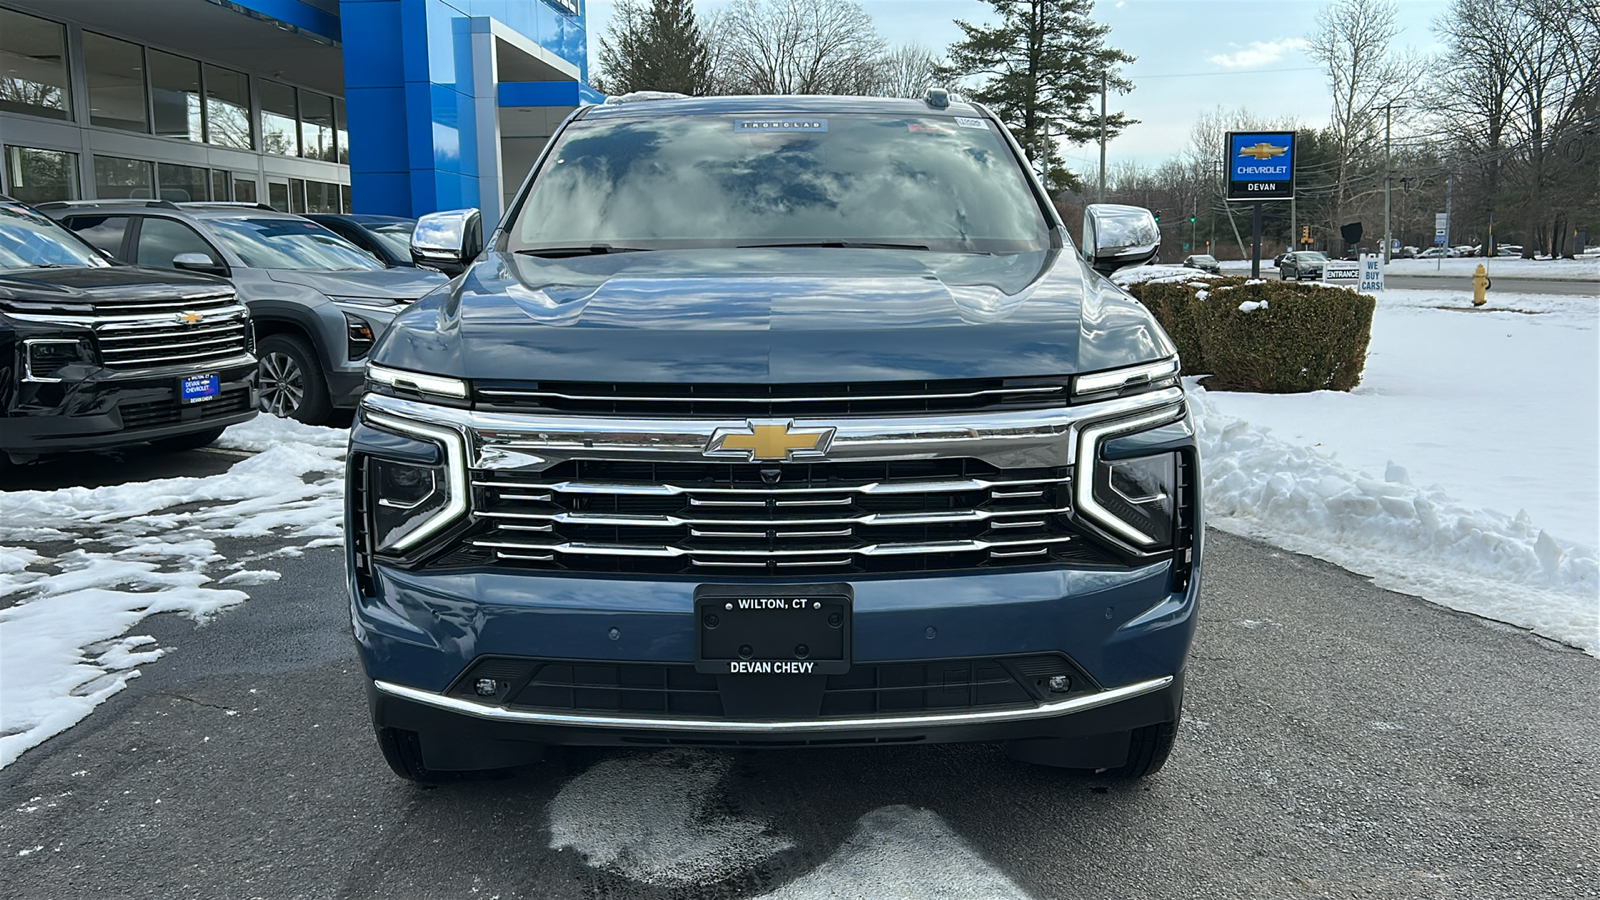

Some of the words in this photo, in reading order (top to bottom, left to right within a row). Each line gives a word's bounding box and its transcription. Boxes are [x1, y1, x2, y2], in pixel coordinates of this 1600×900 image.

[1237, 166, 1287, 174] CHEVROLET
[1247, 183, 1276, 191] DEVAN
[1367, 261, 1379, 270] WE
[1327, 270, 1359, 278] ENTRANCE
[1365, 271, 1380, 280] BUY
[1361, 281, 1383, 290] CARS!
[738, 599, 789, 610] WILTON,
[792, 599, 807, 609] CT
[730, 661, 771, 673] DEVAN
[774, 661, 814, 673] CHEVY
